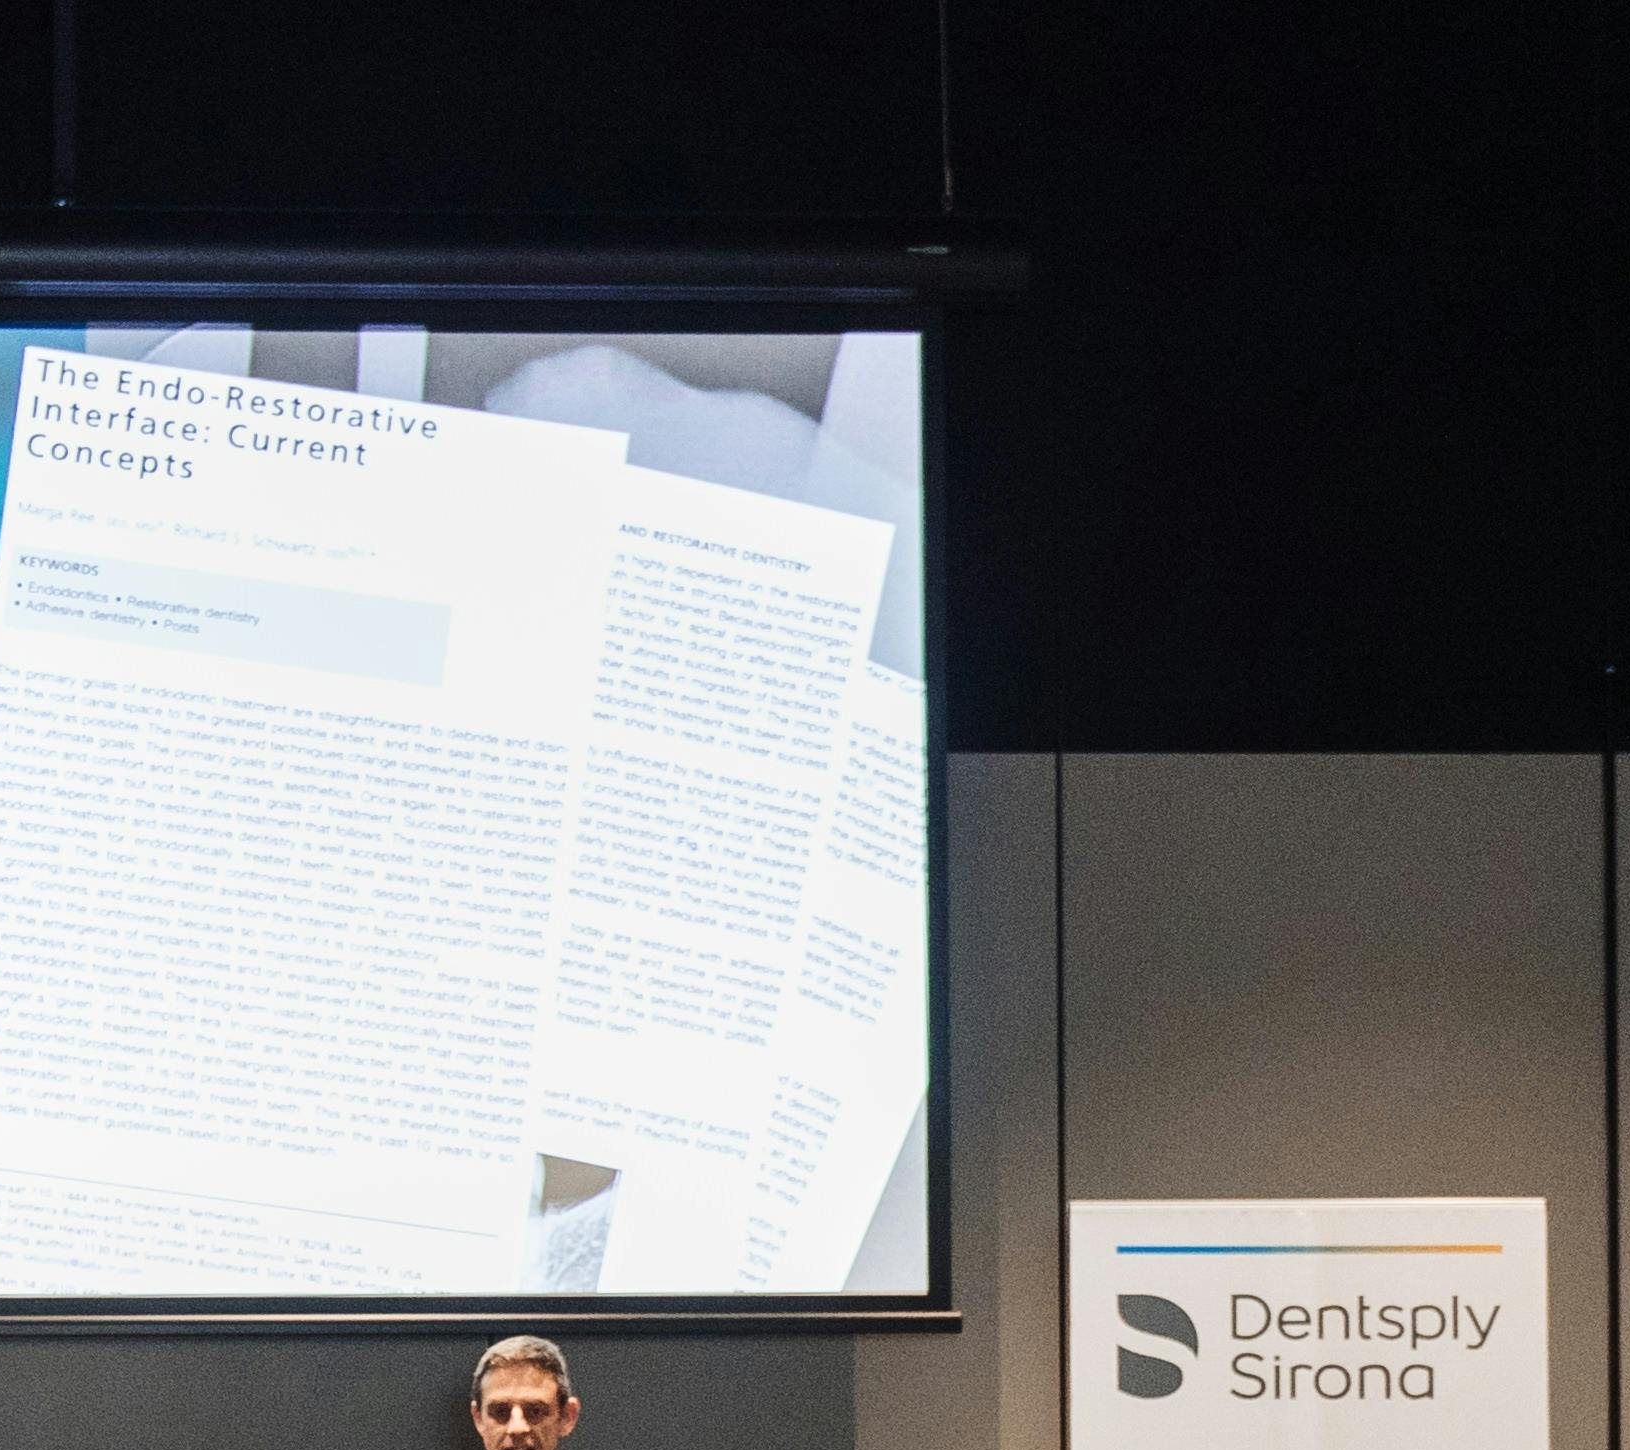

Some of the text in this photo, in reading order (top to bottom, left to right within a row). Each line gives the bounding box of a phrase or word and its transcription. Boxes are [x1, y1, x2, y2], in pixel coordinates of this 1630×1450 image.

[38, 358, 438, 440] The Endo-Restorative
[31, 395, 367, 467] Interface: Current
[27, 433, 193, 480] Concepts
[19, 555, 99, 577] KEYWORDS
[618, 523, 810, 571] AND RESTORATIVE DENTISTRY
[26, 600, 199, 634] Adhesive dentistry Posts
[28, 581, 260, 627] Endodontics Restorative dentistry
[1230, 1294, 1500, 1349] Dentsply
[1230, 1353, 1435, 1400] Sirona
